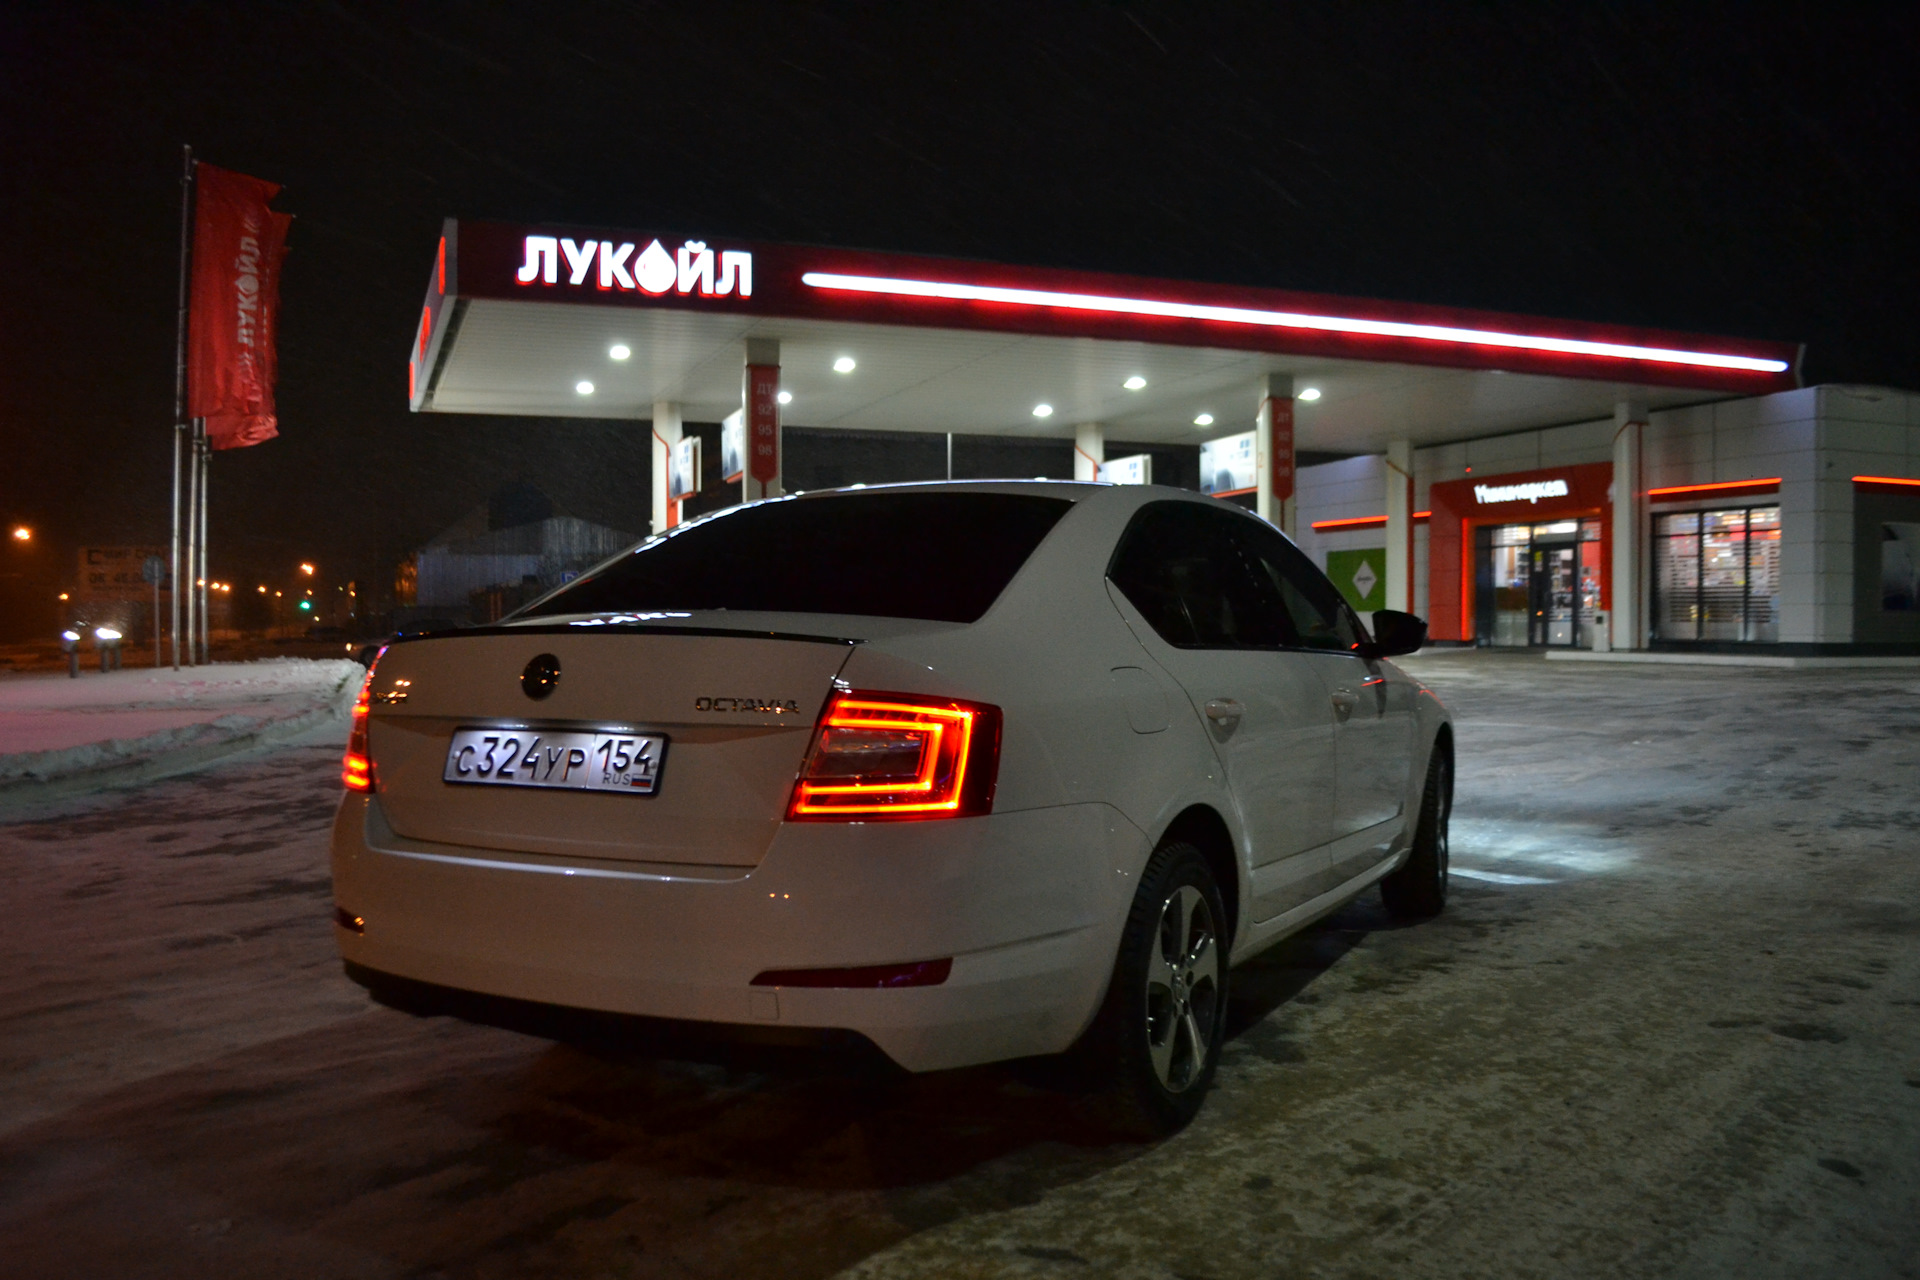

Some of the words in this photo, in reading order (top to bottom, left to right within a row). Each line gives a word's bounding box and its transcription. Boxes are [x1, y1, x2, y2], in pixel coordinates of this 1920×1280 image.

[516, 235, 752, 298] ЛУКОЙЛ
[695, 697, 800, 714] OCTAVIA
[597, 738, 653, 775] 154
[602, 771, 632, 787] RUS
